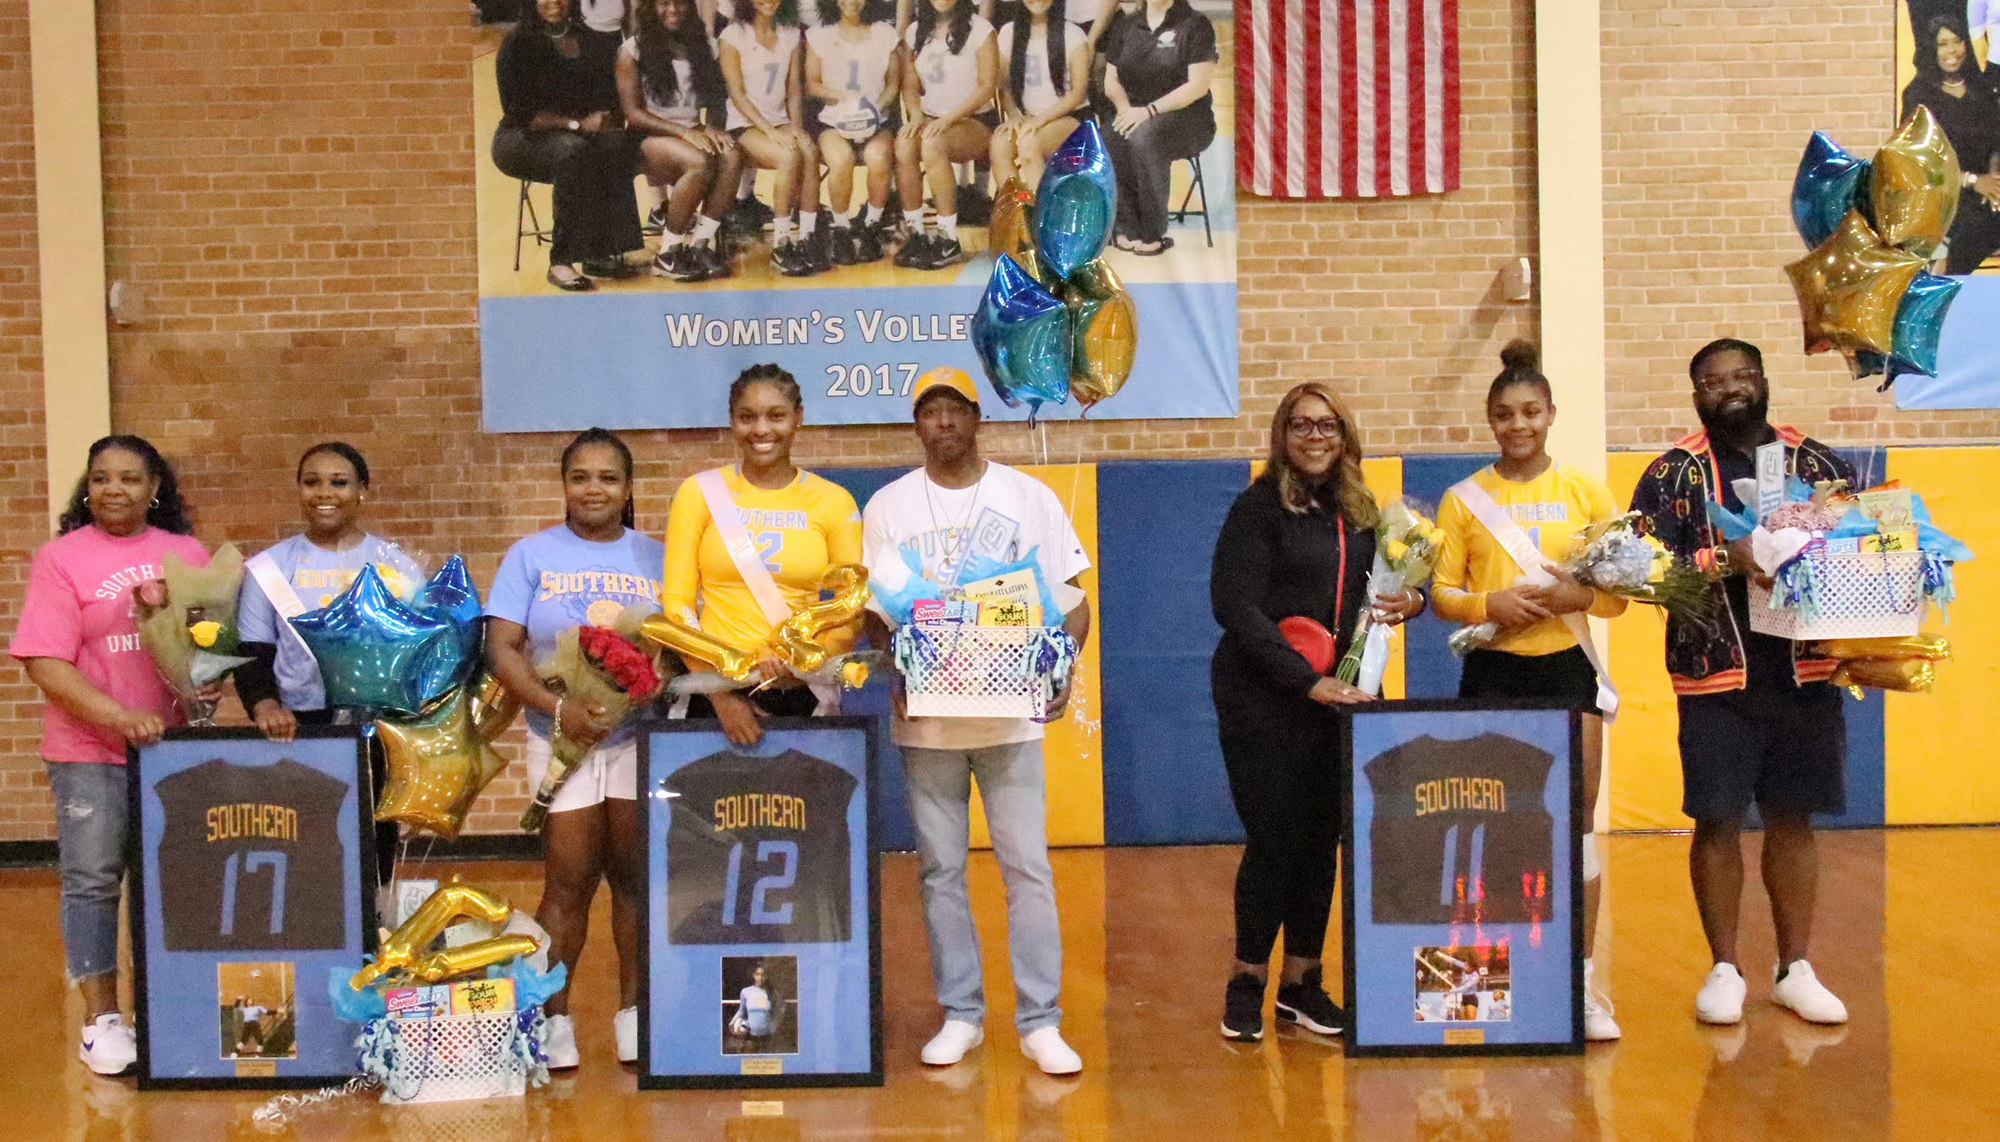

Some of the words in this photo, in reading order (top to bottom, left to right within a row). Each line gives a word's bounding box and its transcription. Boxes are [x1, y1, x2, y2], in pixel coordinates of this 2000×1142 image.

[855, 309, 974, 343] VOLLE
[825, 363, 919, 397] 2017
[736, 508, 807, 529] UTHERN
[96, 564, 164, 600] SOUTH
[107, 633, 142, 653] UNI
[713, 793, 805, 832] SOUTHERN
[1415, 777, 1505, 817] SOUTHERN
[206, 803, 298, 842] SOUTHERN
[721, 840, 799, 926] 12
[1440, 823, 1485, 906] 11
[220, 850, 288, 936] 17
